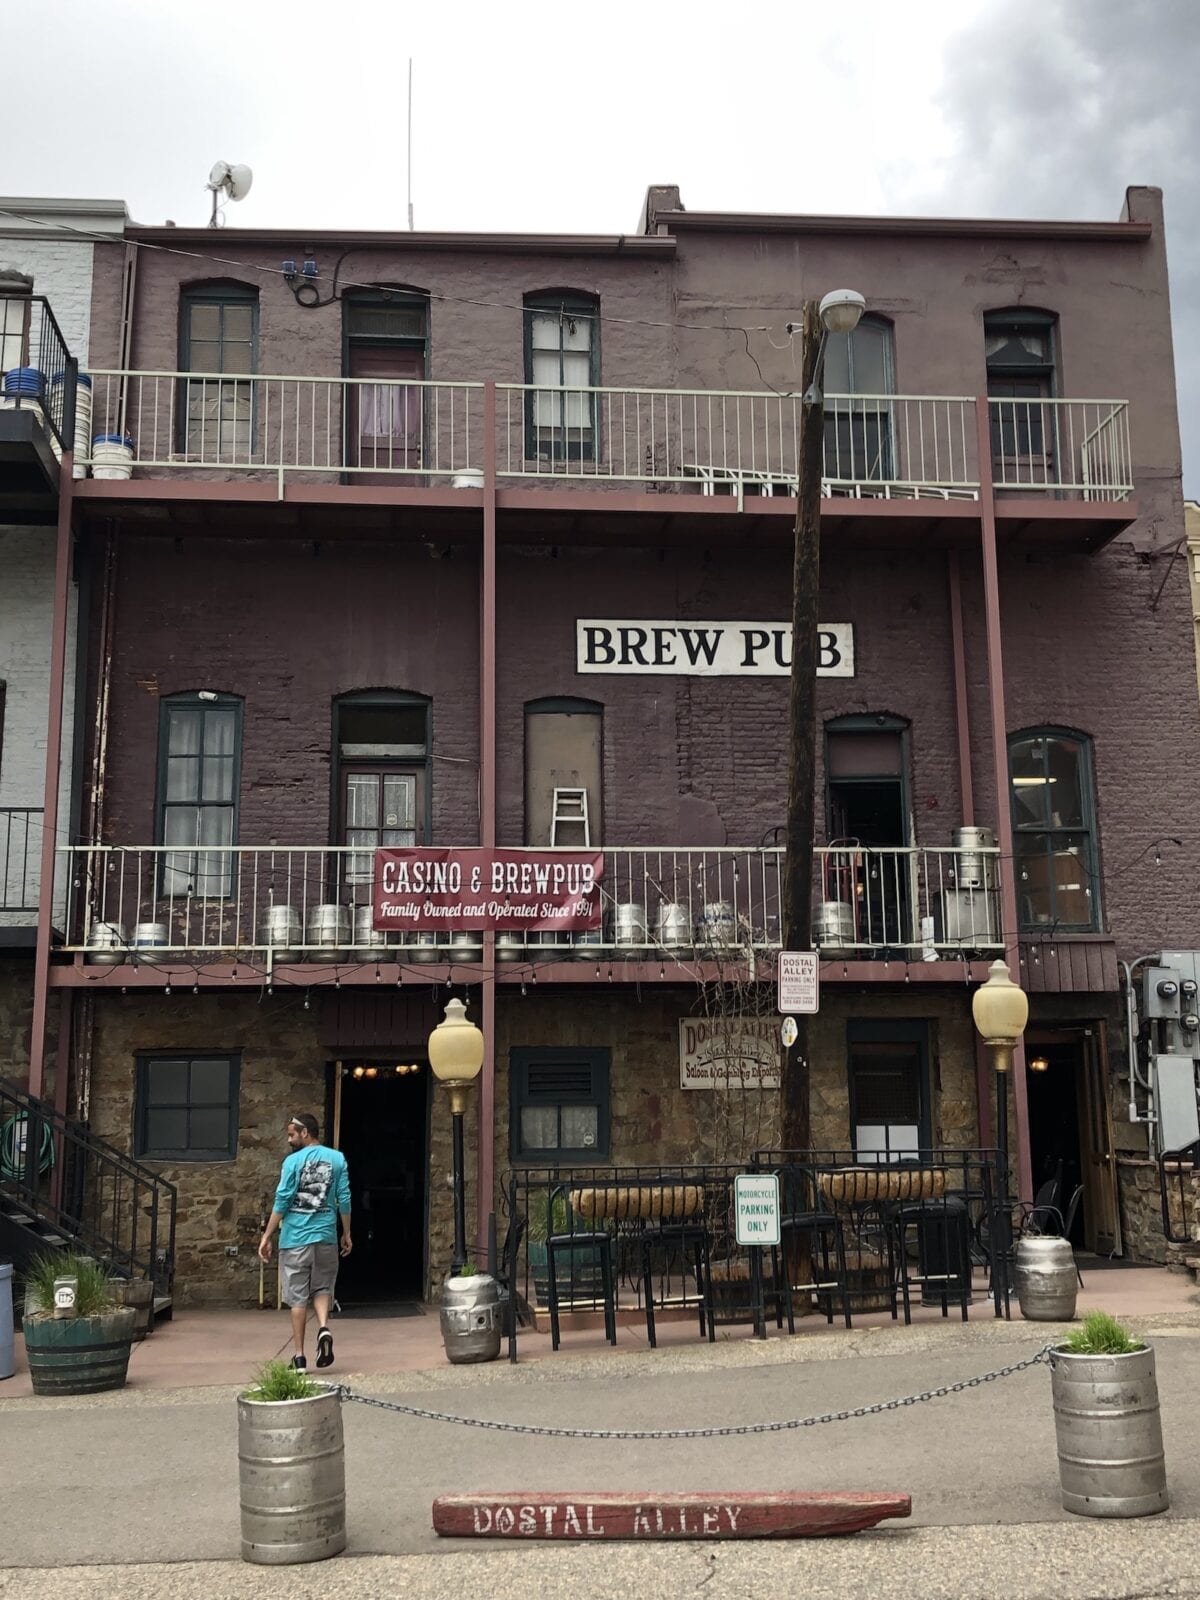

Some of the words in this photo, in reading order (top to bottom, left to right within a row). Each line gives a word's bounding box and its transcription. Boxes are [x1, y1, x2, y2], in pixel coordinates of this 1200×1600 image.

[583, 627, 724, 666] BREW
[740, 630, 842, 669] PUB
[383, 861, 461, 894] CASINO
[470, 866, 482, 893] &
[491, 861, 594, 895] BREWPUB
[381, 901, 420, 921] Family
[423, 901, 461, 917] Owned
[463, 902, 485, 917] and
[488, 901, 538, 920] Operated
[540, 902, 569, 918] Since
[571, 901, 593, 917] 1991
[783, 959, 814, 967] DOSTAL
[686, 1062, 709, 1078] Saloon
[738, 1190, 775, 1199] MOTORCYCLE
[740, 1204, 774, 1215] PARKING
[747, 1220, 768, 1232] ONLY
[473, 1505, 605, 1535] DOSTAL
[633, 1504, 742, 1535] ALLEY
